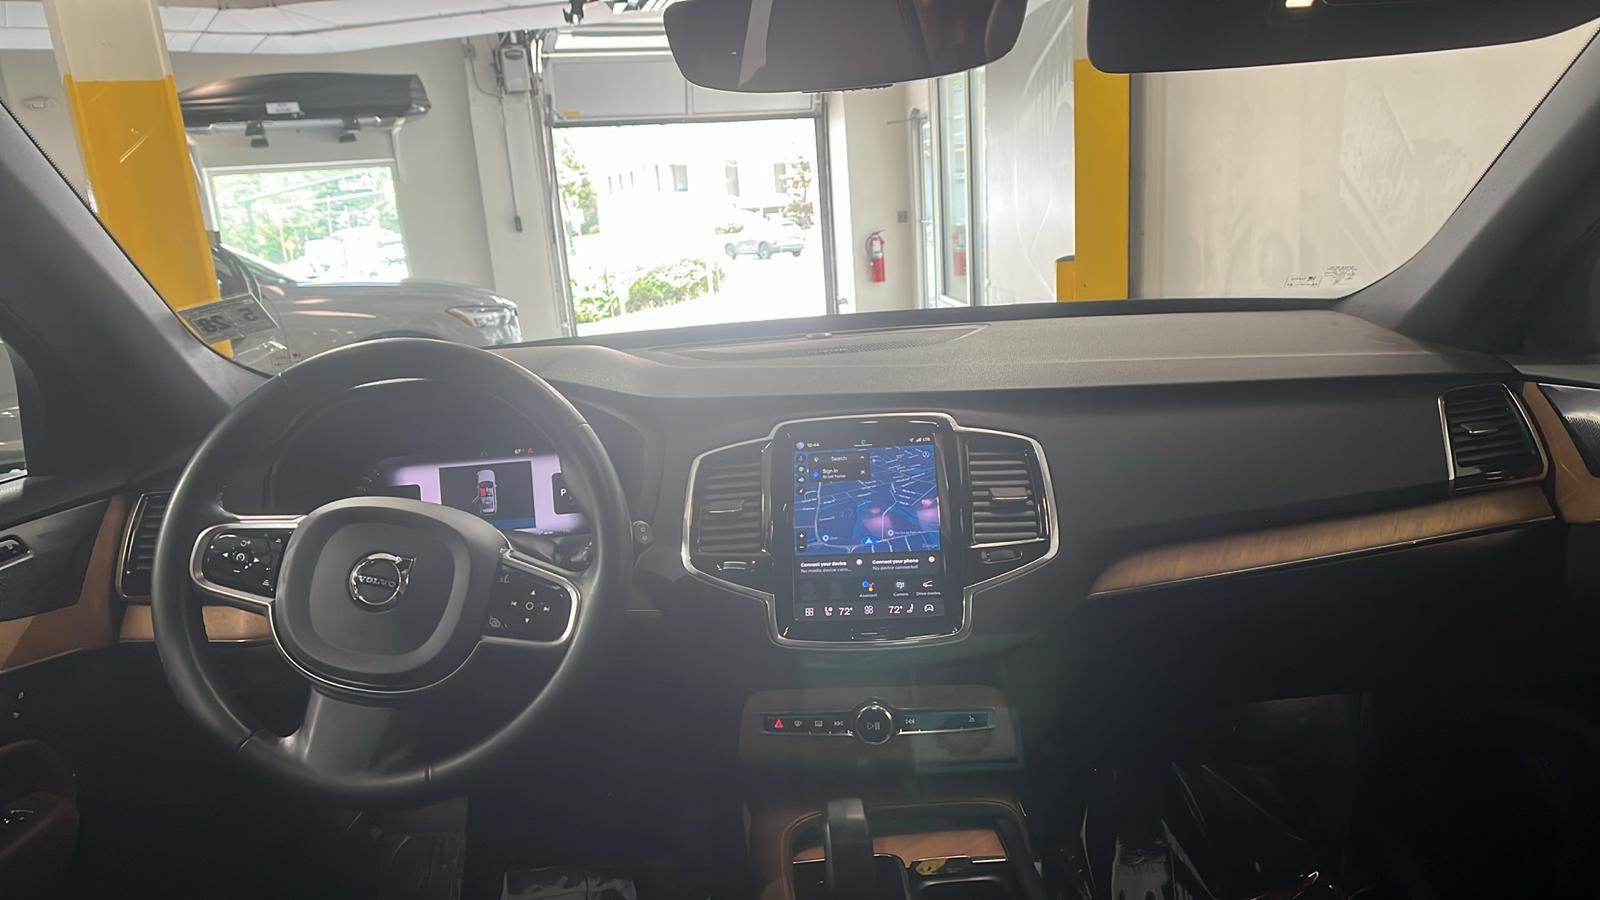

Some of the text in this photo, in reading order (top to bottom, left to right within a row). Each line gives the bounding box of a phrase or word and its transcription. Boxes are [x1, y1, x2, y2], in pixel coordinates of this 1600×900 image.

[560, 488, 567, 497] P
[358, 575, 396, 588] VOLVO
[838, 606, 854, 616] 72°
[888, 605, 903, 614] 72°
